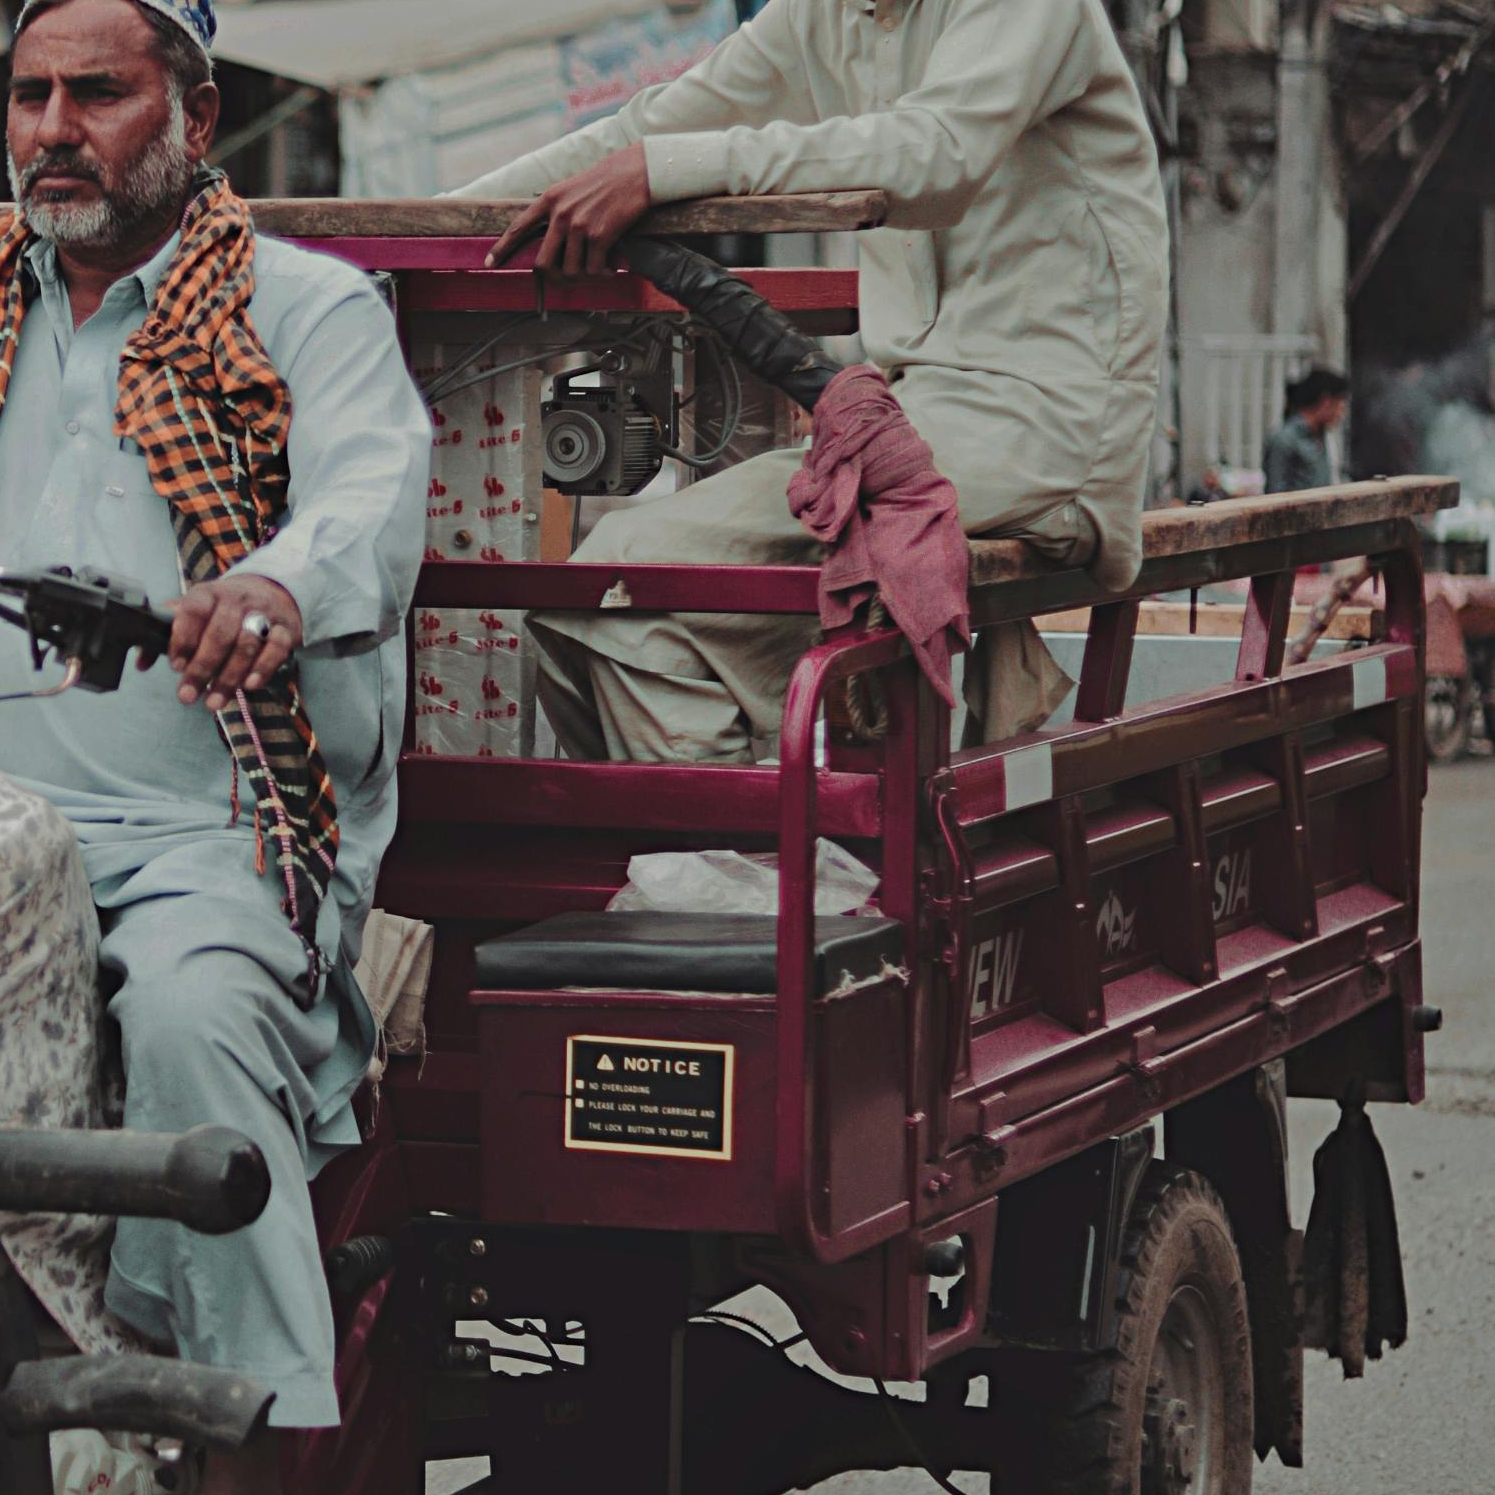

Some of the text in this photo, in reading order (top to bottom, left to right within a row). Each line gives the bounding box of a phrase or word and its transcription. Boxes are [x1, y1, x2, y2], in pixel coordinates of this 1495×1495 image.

[623, 1056, 701, 1076] NOTICE
[588, 1082, 651, 1095] NO OVERLOADING
[588, 1100, 716, 1119] PLEASE LOCK YOUR CARRIAGE AND
[588, 1121, 709, 1140] THE LOCK BUTTON TO KEEP SAFE
